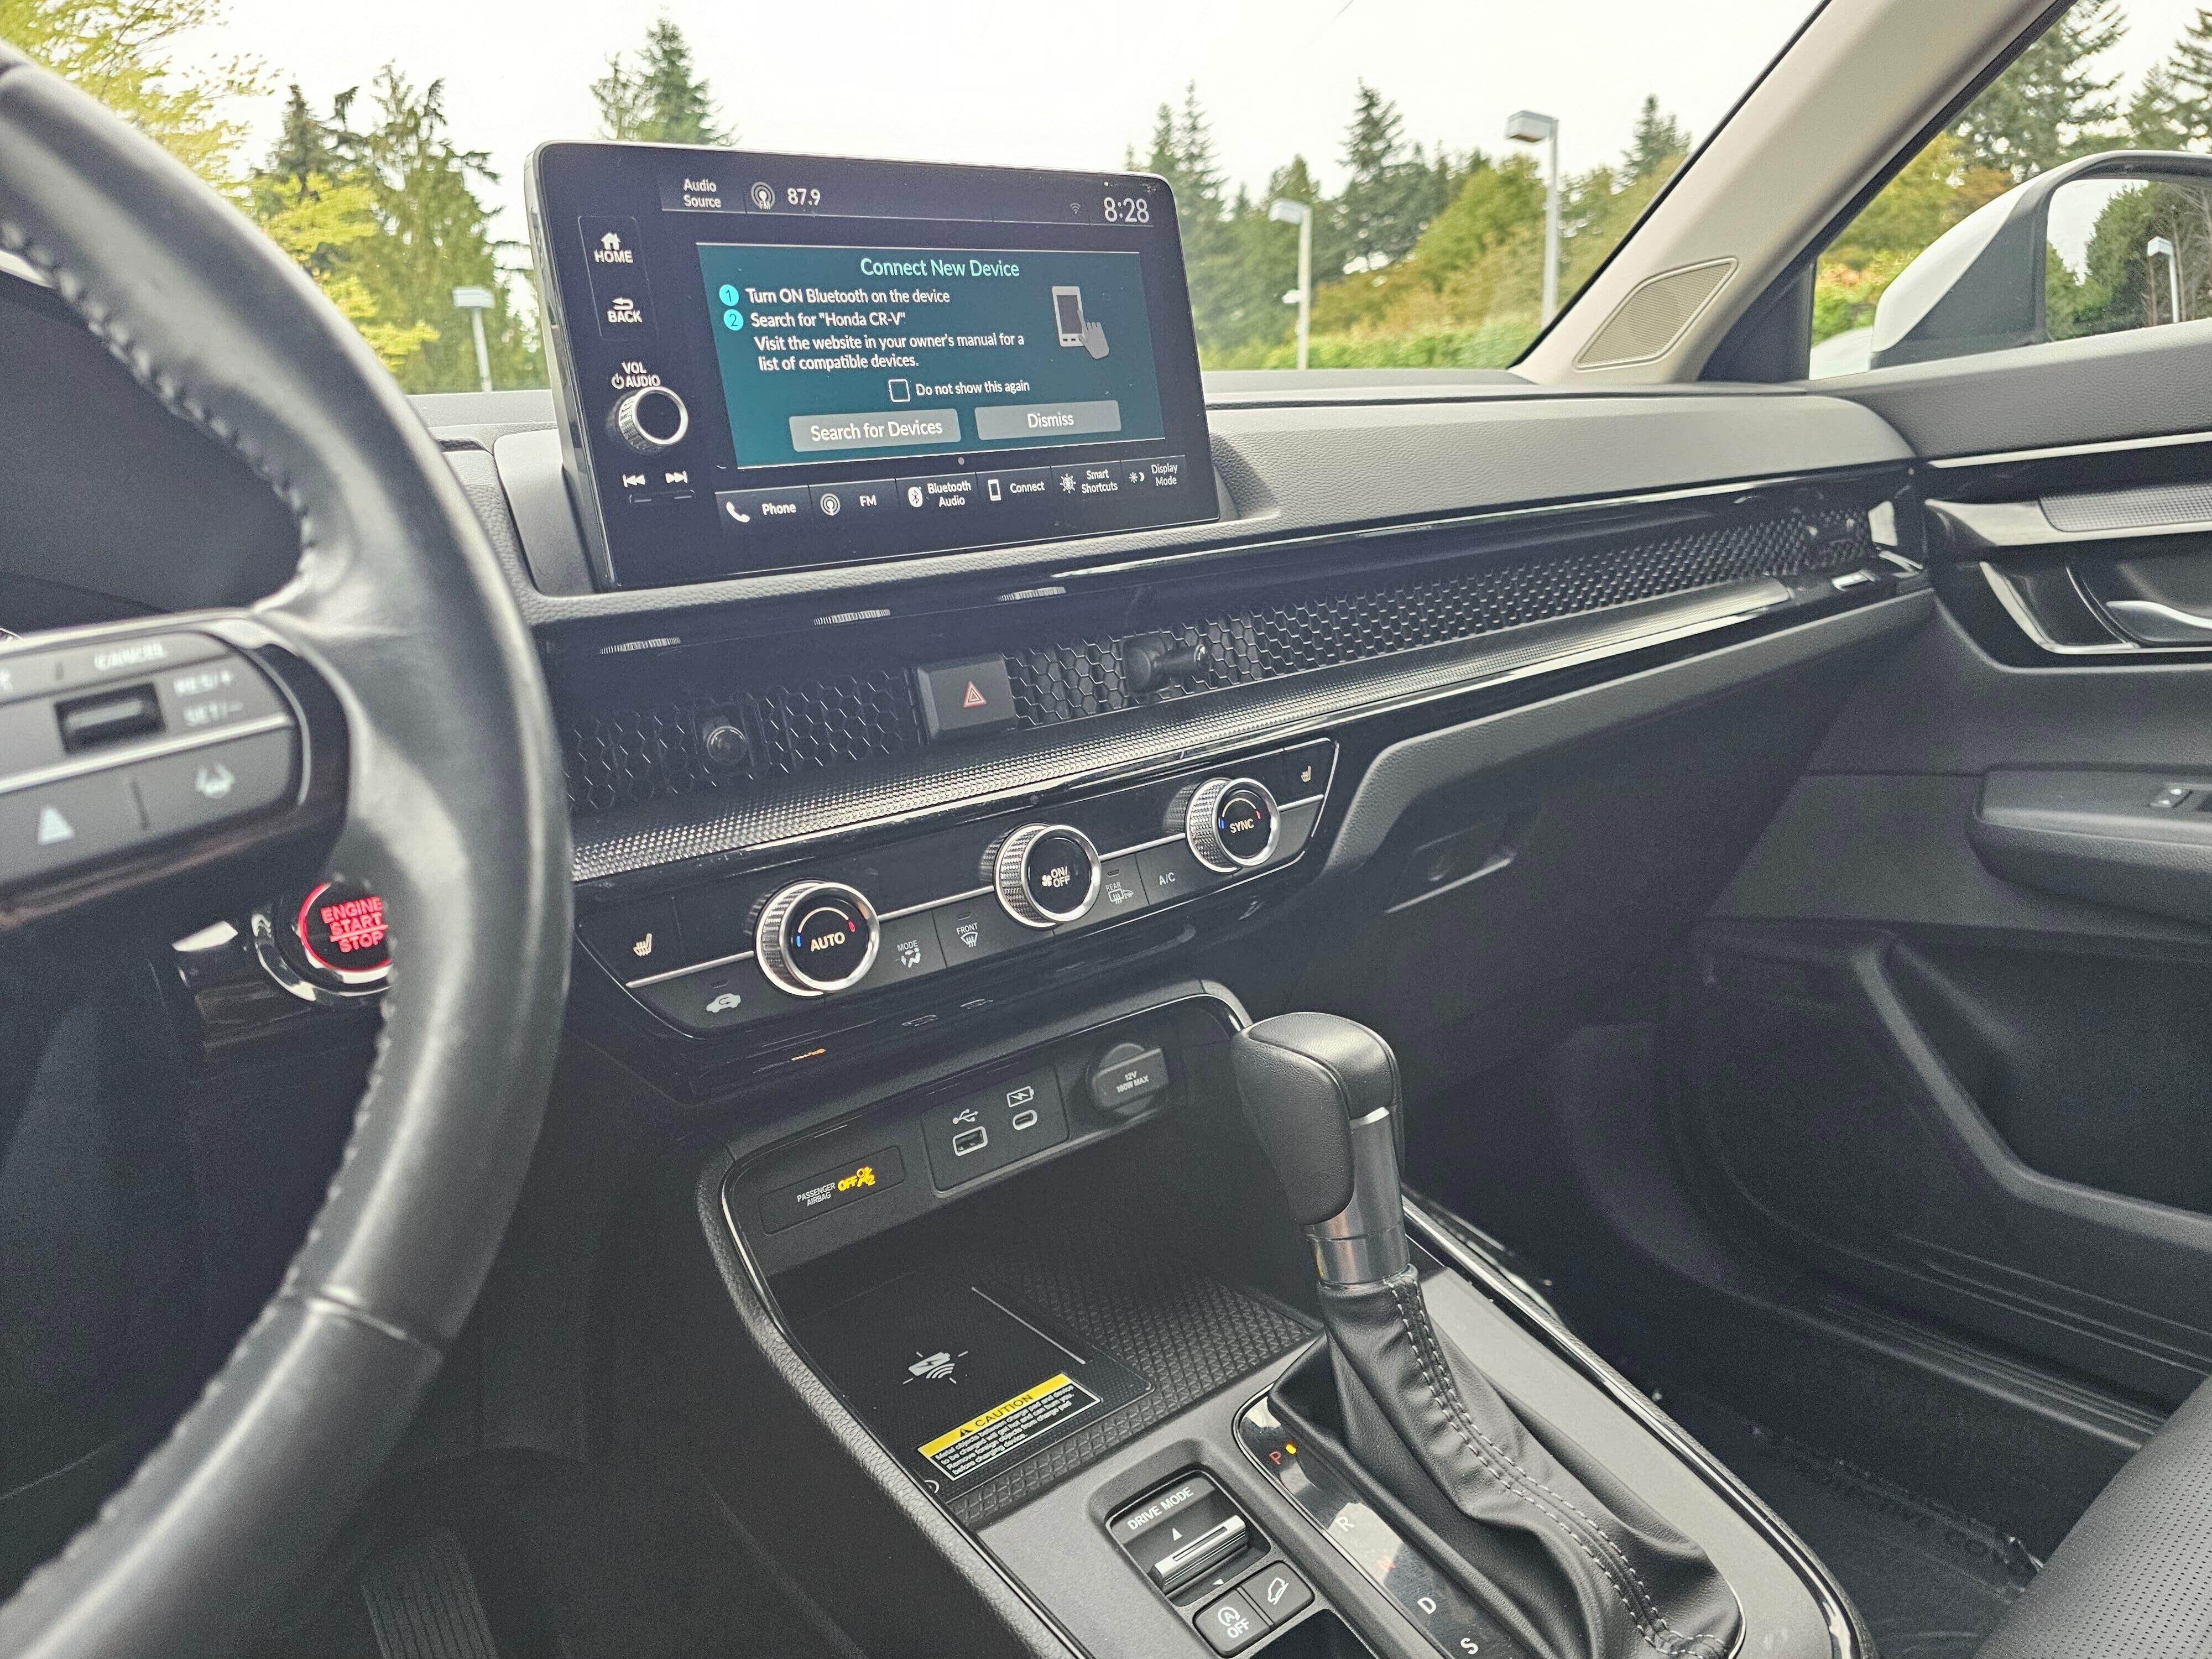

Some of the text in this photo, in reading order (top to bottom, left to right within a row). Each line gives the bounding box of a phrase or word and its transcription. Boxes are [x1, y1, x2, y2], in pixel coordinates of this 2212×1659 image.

[684, 178, 717, 192] Audio
[684, 194, 722, 208] Source
[787, 187, 821, 206] 87.9
[1103, 197, 1149, 223] 8:28
[594, 249, 633, 264] HOME
[860, 258, 1020, 276] Connect New Device
[725, 288, 951, 304] 1 Turn ON Bluetooth on the device
[607, 310, 642, 324] BACK
[728, 311, 905, 328] 2 Search for "Honda CR-V"
[754, 332, 1025, 351] Visit the website in your owner's manual for a
[621, 361, 647, 374] VOL
[758, 353, 920, 372] list of compatible devices.
[625, 374, 660, 388] AUDIO
[915, 379, 1030, 396] Do not show this again
[1026, 413, 1074, 429] Dismiss
[810, 420, 943, 442] Search for Devices
[1086, 469, 1109, 481] Smart
[1151, 462, 1178, 475] Display
[926, 481, 972, 494] Bluetooth
[1009, 481, 1045, 494] Connect
[1081, 481, 1118, 494] Shortcuts
[1155, 476, 1177, 487] Mode
[859, 494, 877, 508] FM
[938, 495, 966, 508] Audio
[761, 502, 797, 516] Phone
[1229, 818, 1254, 834] SYNC
[1053, 874, 1071, 888] OFF
[1105, 881, 1121, 891] REAR
[1159, 872, 1176, 885] A/C
[320, 895, 383, 924] ENGINE
[330, 911, 383, 936] START
[956, 922, 978, 935] FRONT
[338, 931, 384, 953] STOP
[810, 931, 846, 953] AUTO
[896, 940, 919, 952] MODE
[1124, 1071, 1137, 1081] 12V
[1133, 1075, 1150, 1086] MAX
[796, 1175, 858, 1203] PASSENGER OFF
[807, 1192, 832, 1207] AIRBAG
[975, 1394, 1034, 1427] CAUTION
[1269, 1451, 1282, 1465] P
[1127, 1486, 1194, 1530] DRIVE MODE
[1335, 1515, 1355, 1532] R
[1417, 1597, 1437, 1615] D
[1227, 1618, 1249, 1639] OFF
[1460, 1636, 1479, 1656] S
